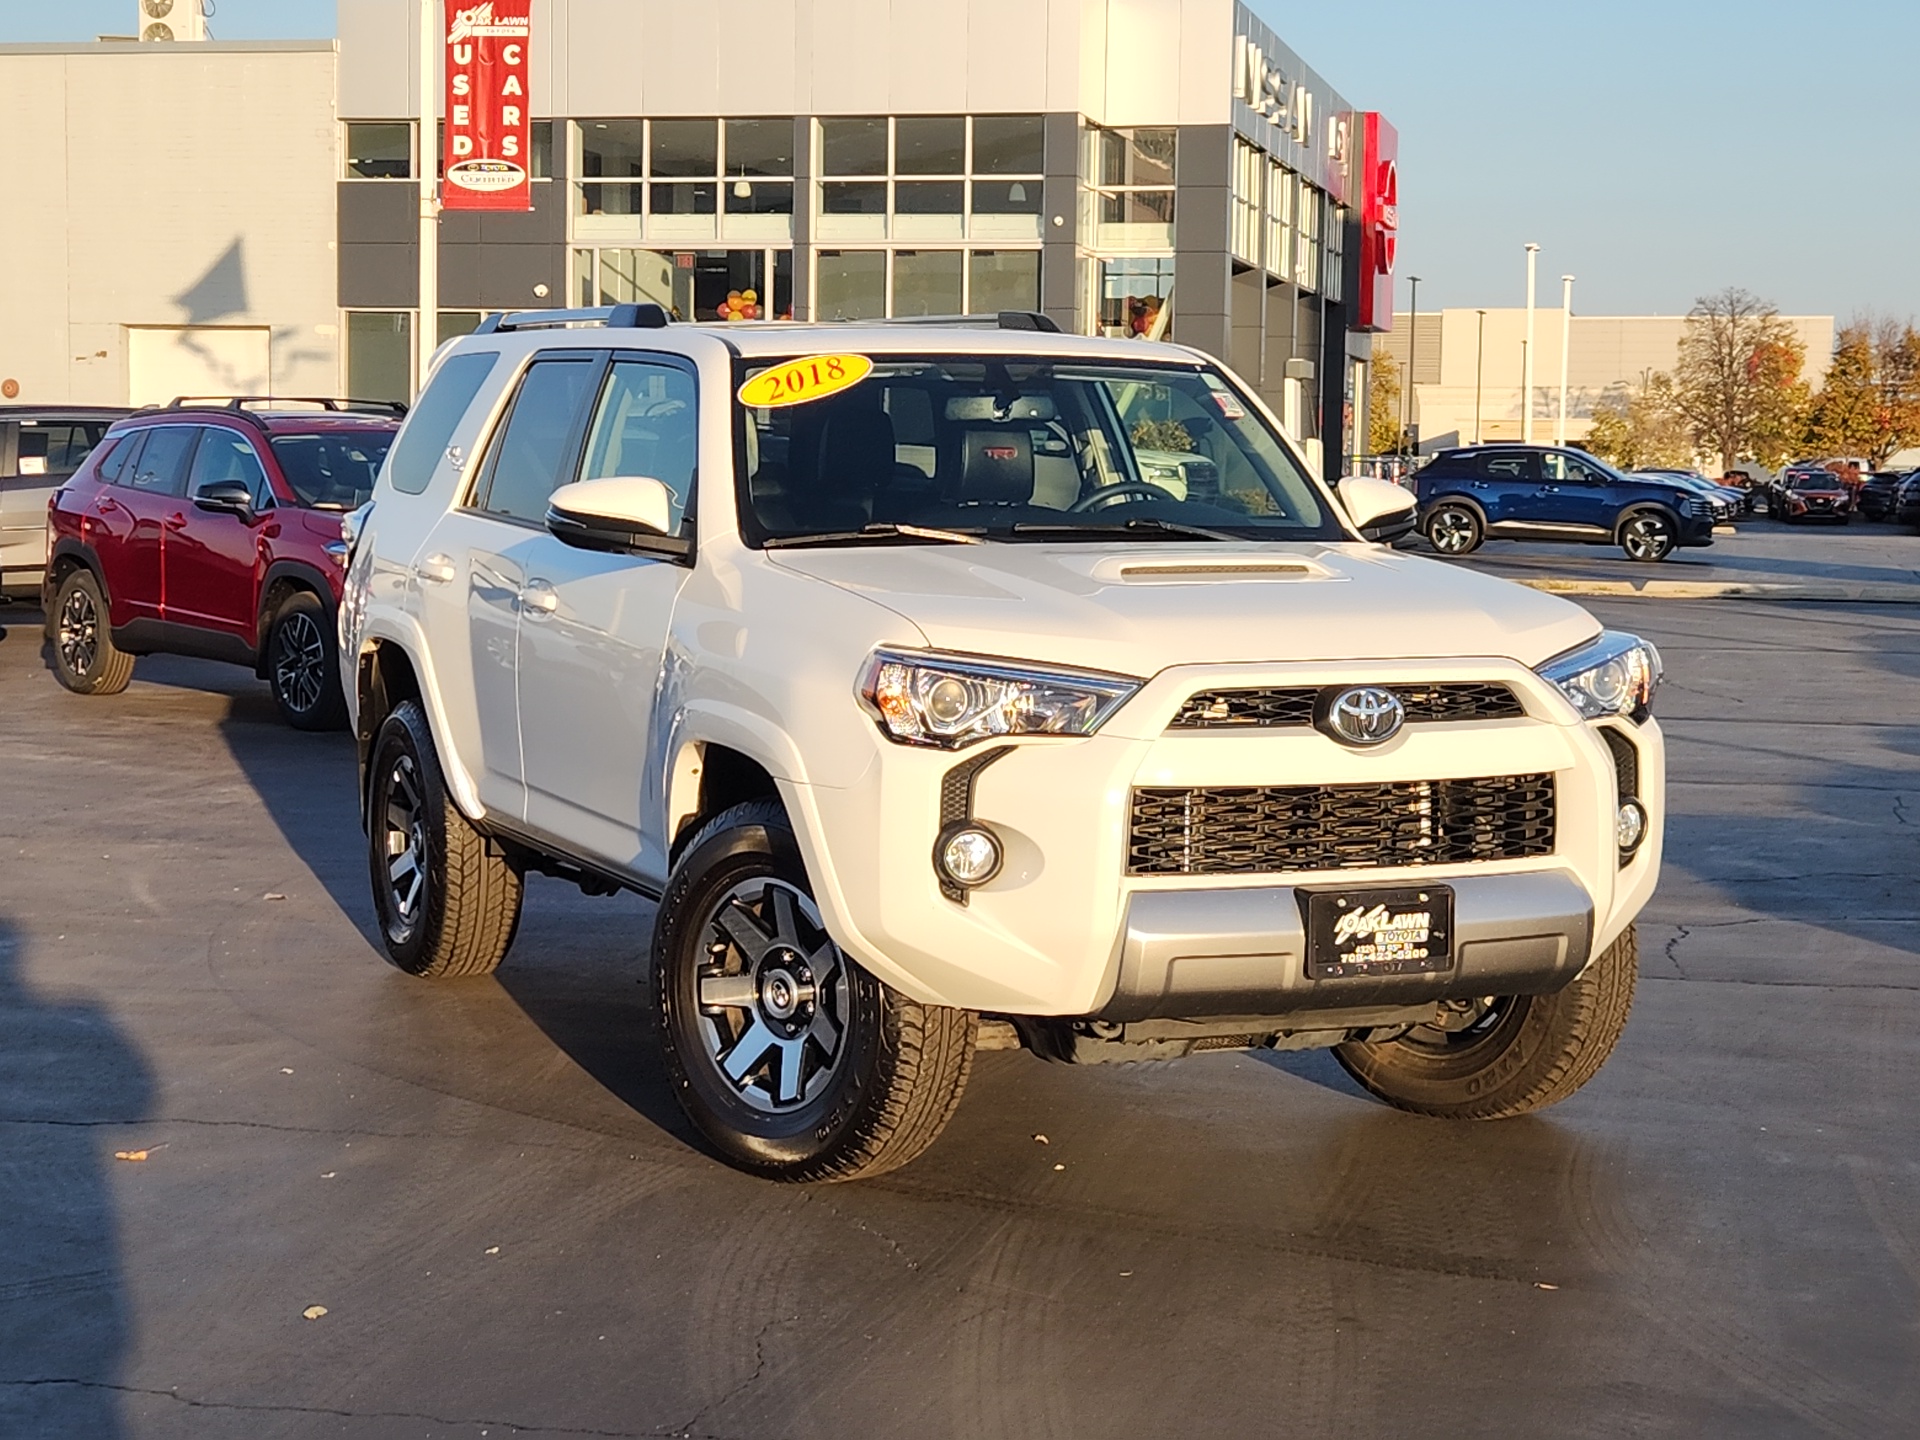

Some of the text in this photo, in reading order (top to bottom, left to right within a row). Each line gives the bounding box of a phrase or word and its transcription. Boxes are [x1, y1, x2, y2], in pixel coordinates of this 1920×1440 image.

[494, 16, 529, 26] LAWN
[452, 44, 473, 156] USED
[501, 44, 523, 157] CARS
[764, 357, 845, 402] 2018
[1382, 929, 1421, 941] TOYOTA
